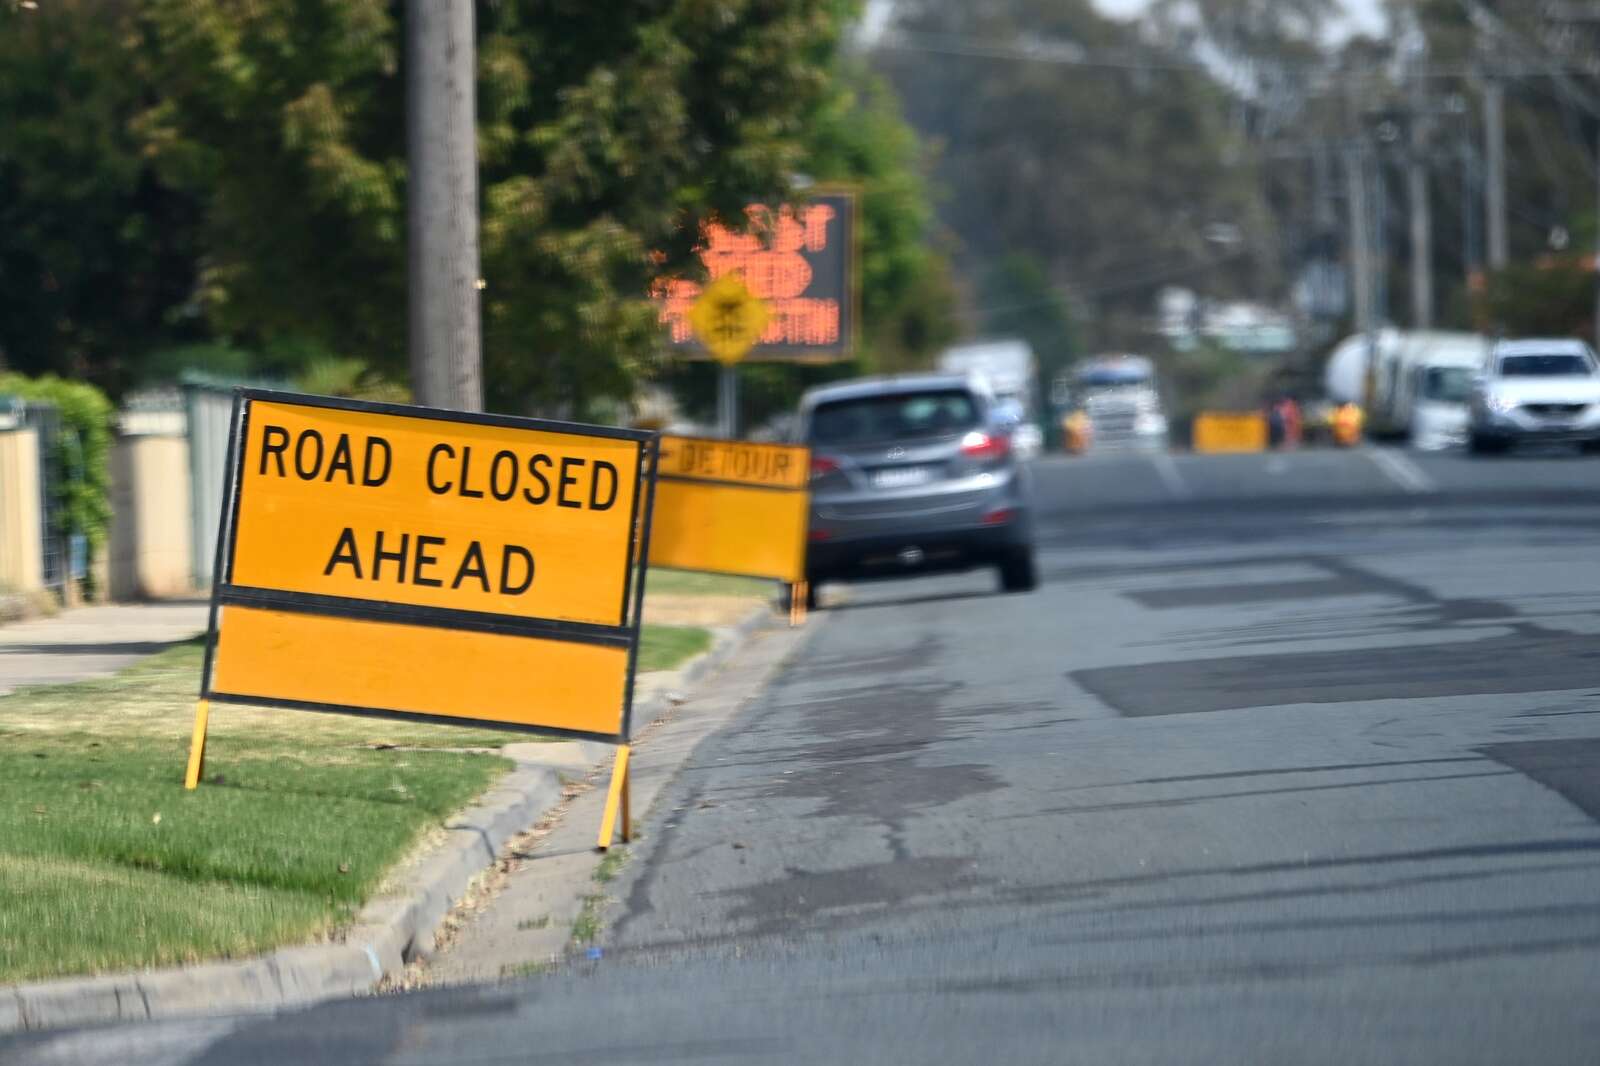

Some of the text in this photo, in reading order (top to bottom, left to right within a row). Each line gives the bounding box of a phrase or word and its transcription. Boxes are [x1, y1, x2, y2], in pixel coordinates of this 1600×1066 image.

[259, 425, 619, 511] ROAD CLOSED
[679, 444, 790, 479] DETOUR
[323, 527, 535, 596] AHEAD
